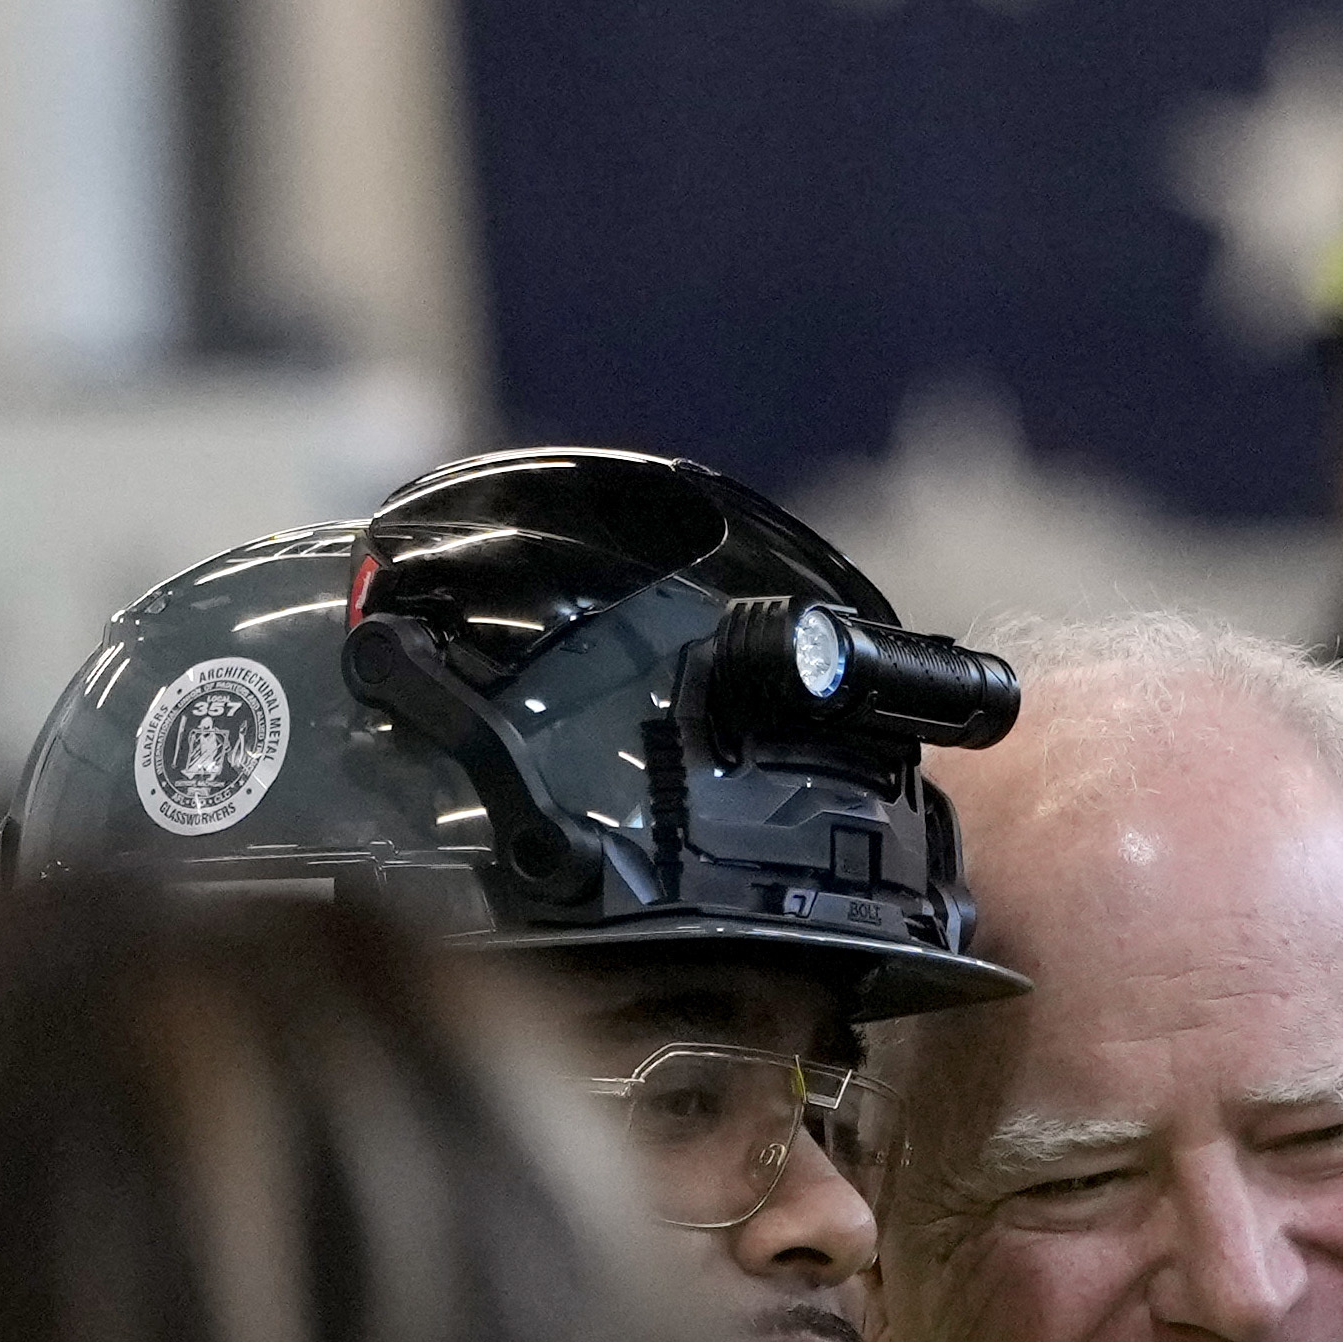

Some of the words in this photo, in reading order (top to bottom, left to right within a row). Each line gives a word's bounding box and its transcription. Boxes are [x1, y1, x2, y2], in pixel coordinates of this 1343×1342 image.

[177, 689, 201, 708] UNION
[207, 694, 231, 703] LOCAL
[191, 702, 243, 717] 357
[199, 666, 279, 714] ARCHITECTURAL
[263, 716, 281, 761] METAL
[142, 704, 169, 767] GLAZIERS
[159, 801, 236, 826] GLASSWORKERS
[851, 901, 882, 921] BOLT
